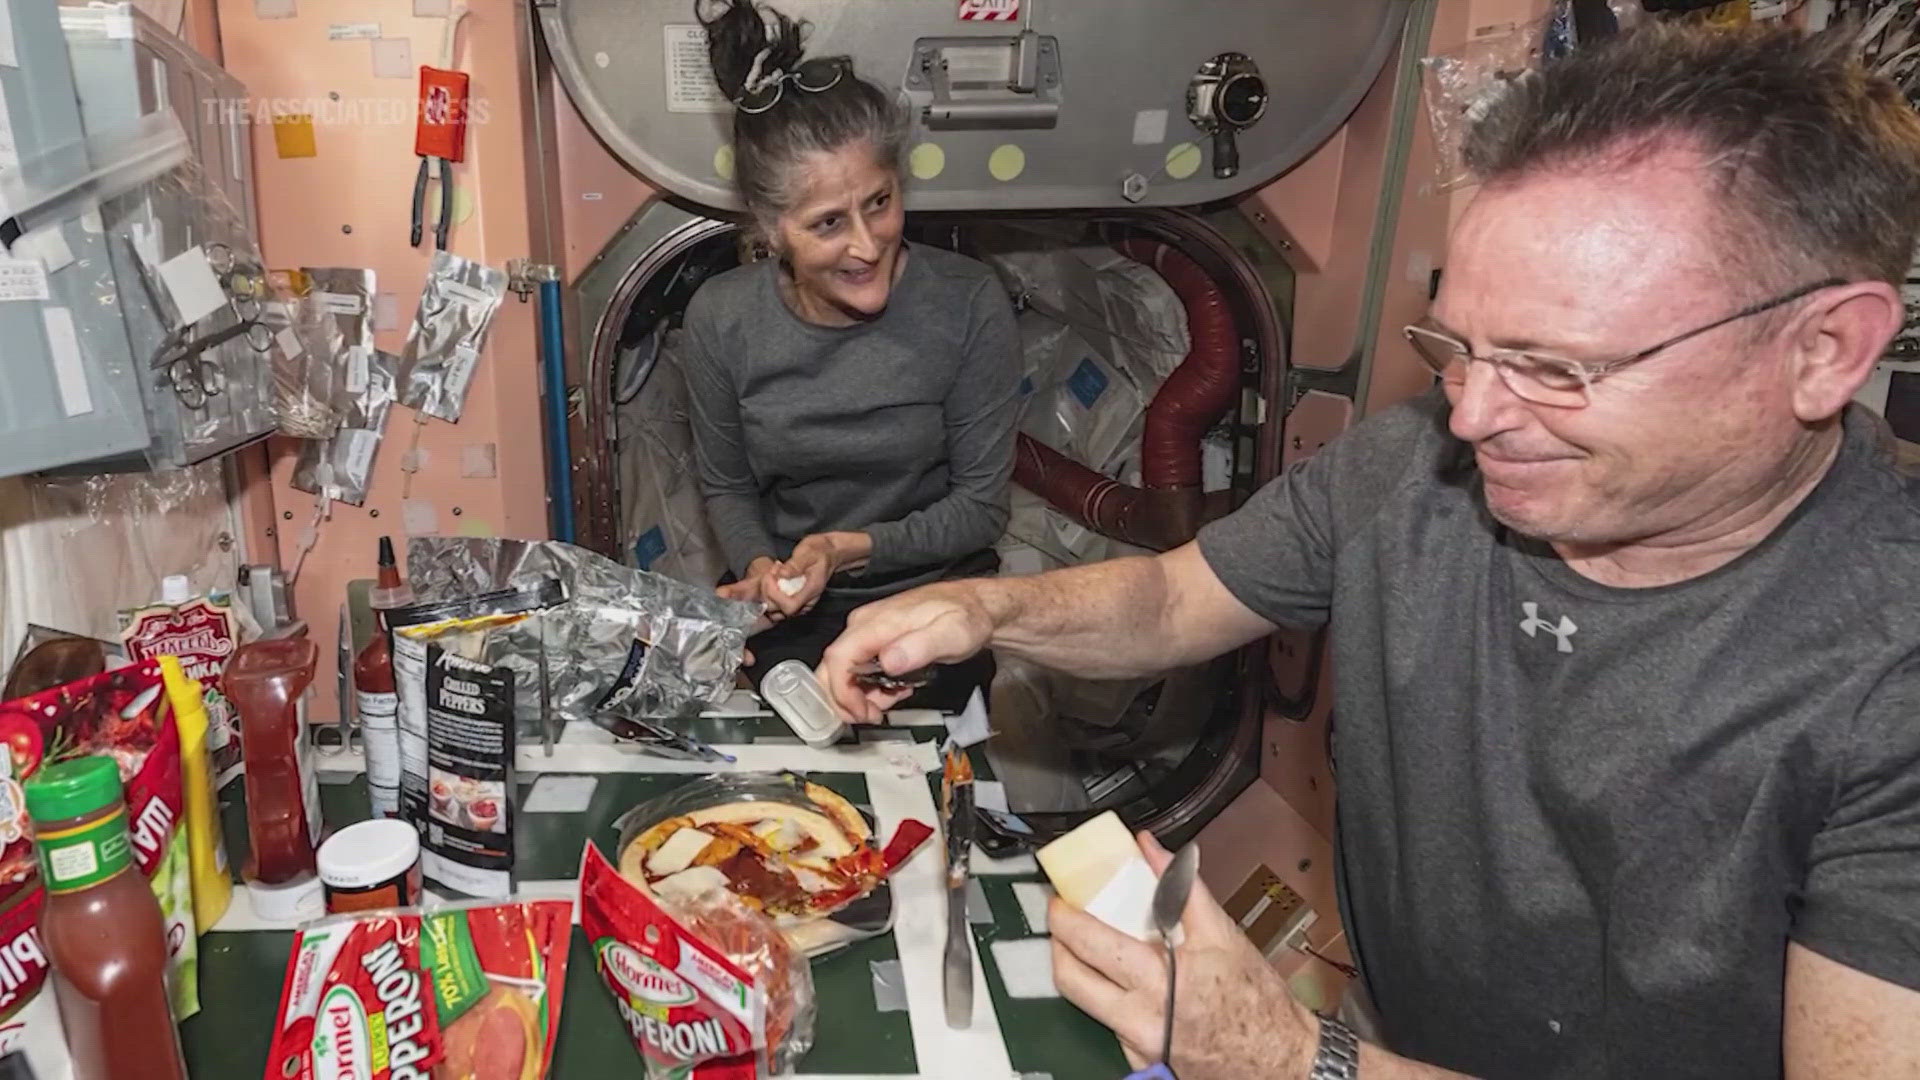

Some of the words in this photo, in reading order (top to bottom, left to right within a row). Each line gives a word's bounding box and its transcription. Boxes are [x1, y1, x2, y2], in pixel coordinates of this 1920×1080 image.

[184, 660, 222, 681] ИКА
[613, 950, 683, 996] Hormel
[360, 939, 431, 1080] PPERONI
[618, 997, 730, 1061] PPERONI
[329, 1004, 355, 1080] ormel
